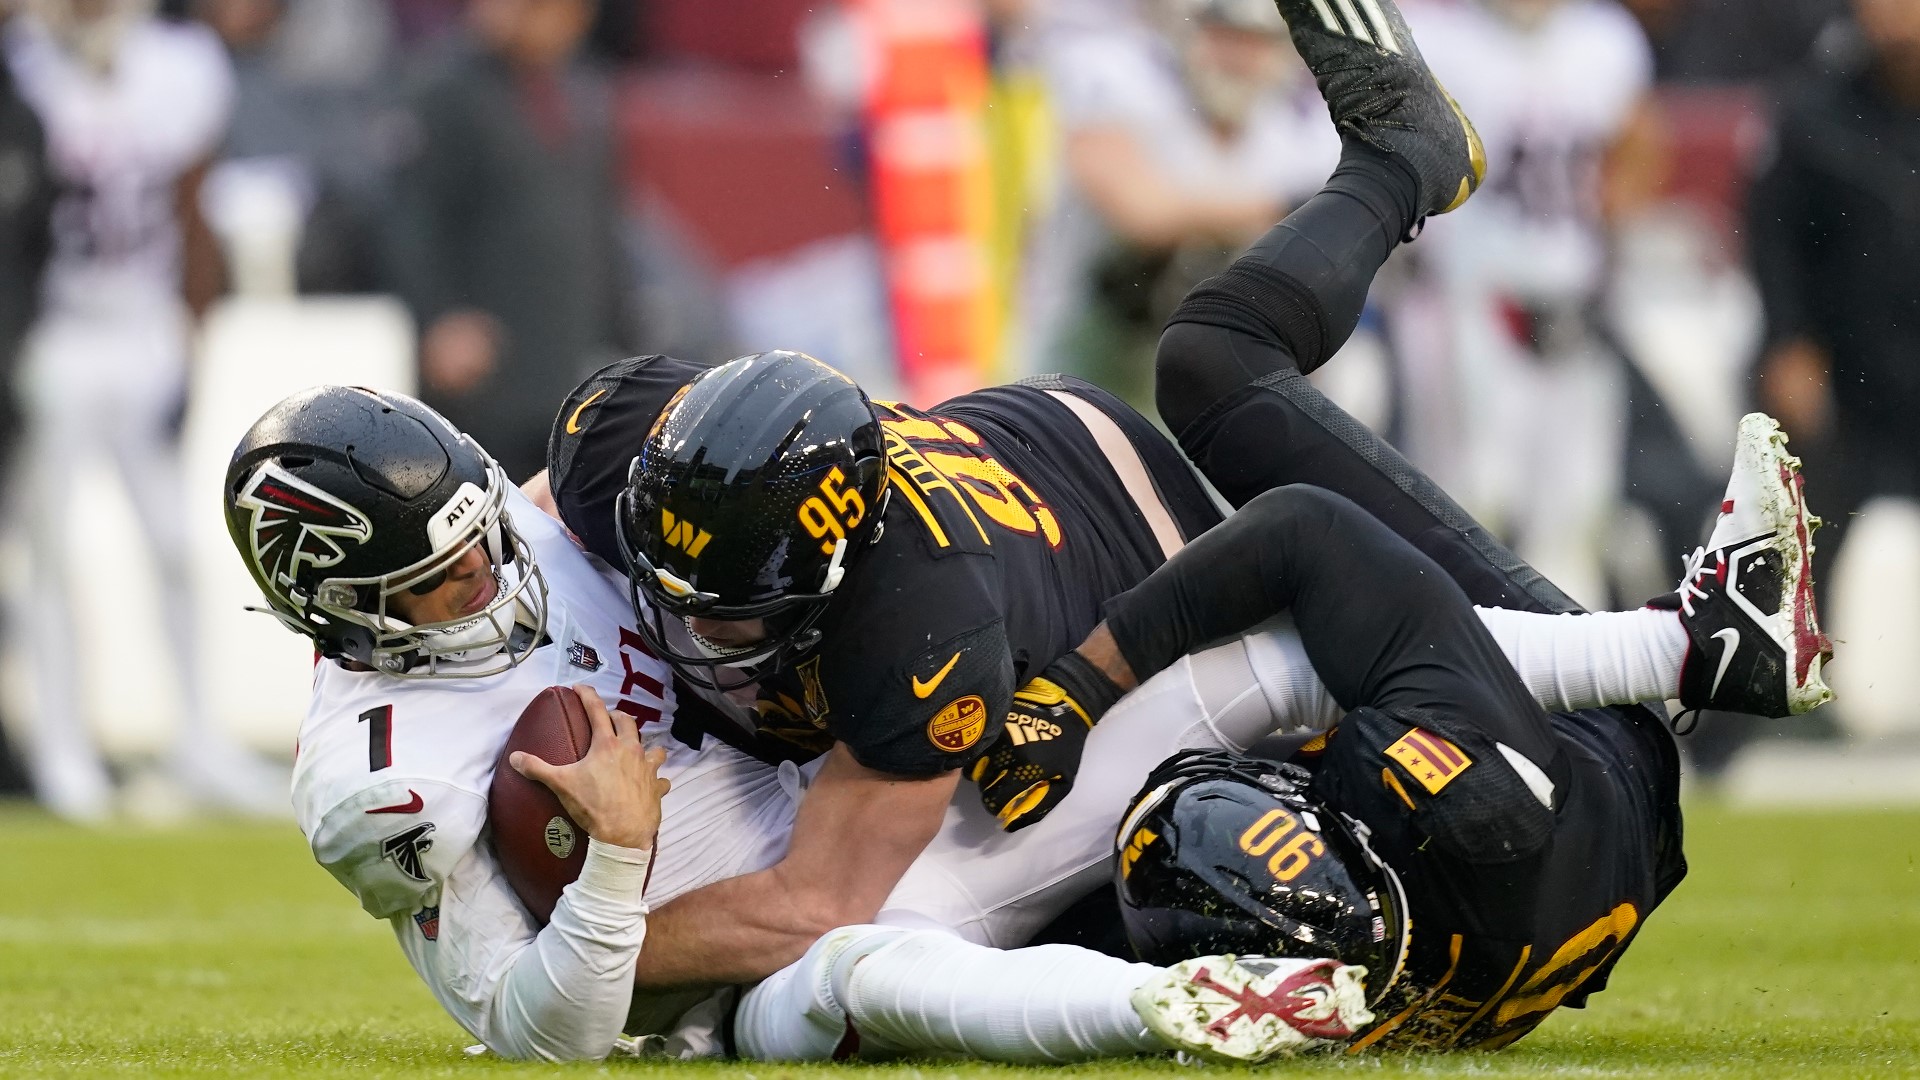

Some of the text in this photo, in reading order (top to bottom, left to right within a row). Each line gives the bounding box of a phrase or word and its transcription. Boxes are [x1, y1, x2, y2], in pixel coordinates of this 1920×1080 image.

[446, 496, 475, 528] ATL
[797, 465, 866, 556] 95
[942, 712, 956, 722] 19
[966, 727, 977, 738] 32
[1006, 711, 1063, 737] adida
[357, 704, 393, 773] 1
[1239, 808, 1326, 883] 90
